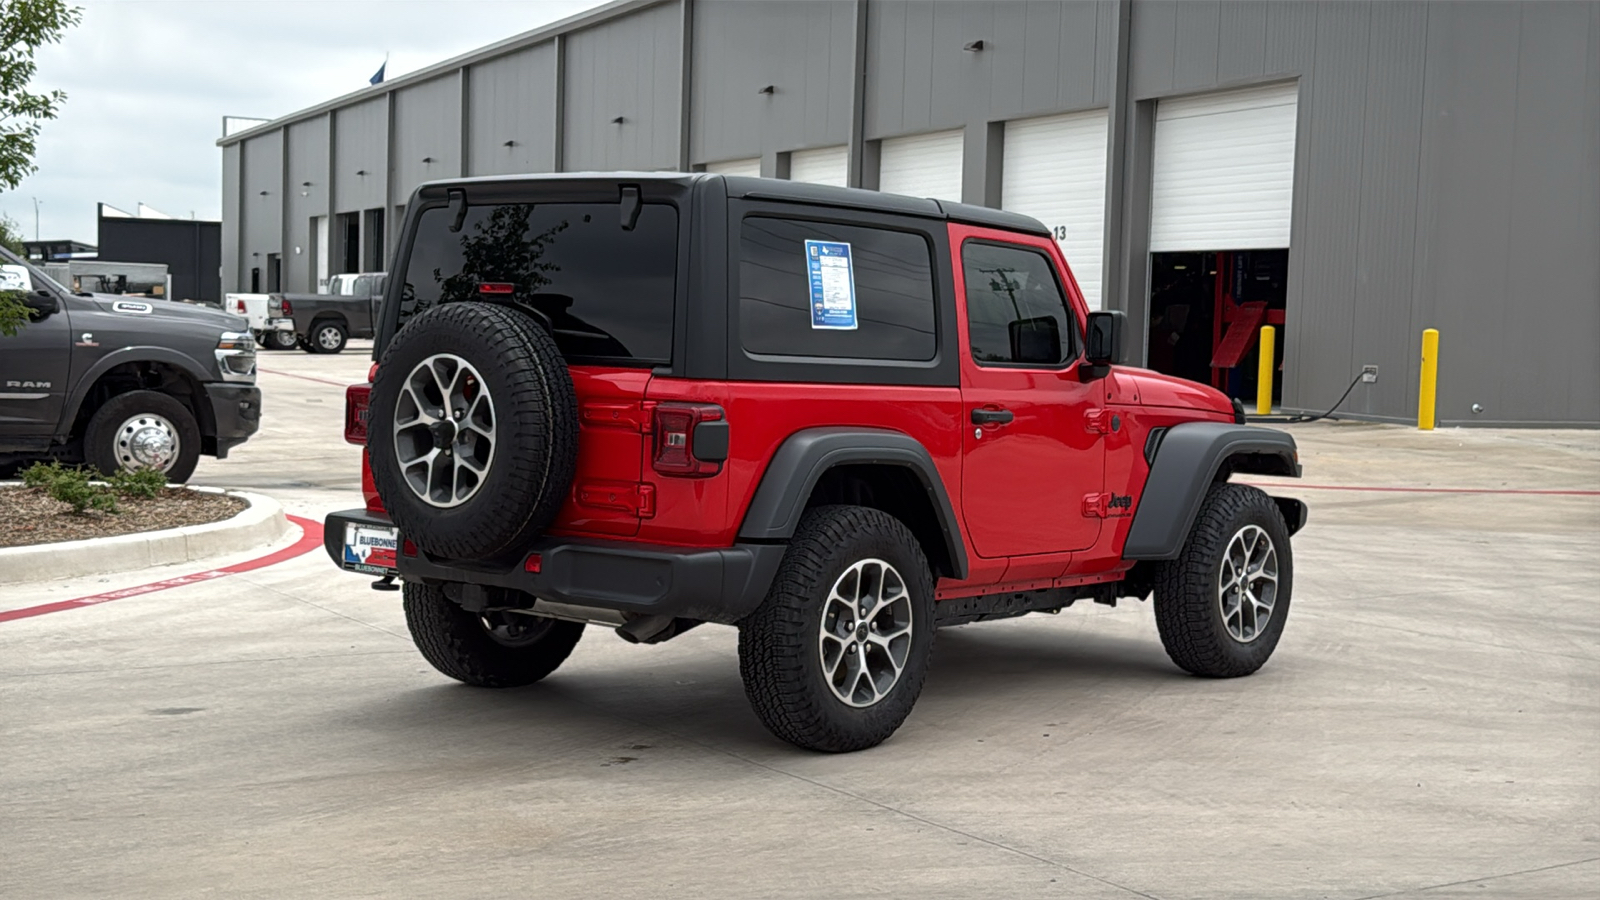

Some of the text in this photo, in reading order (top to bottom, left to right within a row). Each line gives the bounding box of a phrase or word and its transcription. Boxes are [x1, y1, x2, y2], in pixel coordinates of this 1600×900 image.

[1053, 225, 1067, 241] 13
[6, 380, 52, 388] RAM
[1108, 492, 1131, 511] Jeep
[360, 536, 397, 548] BLUEBONNE
